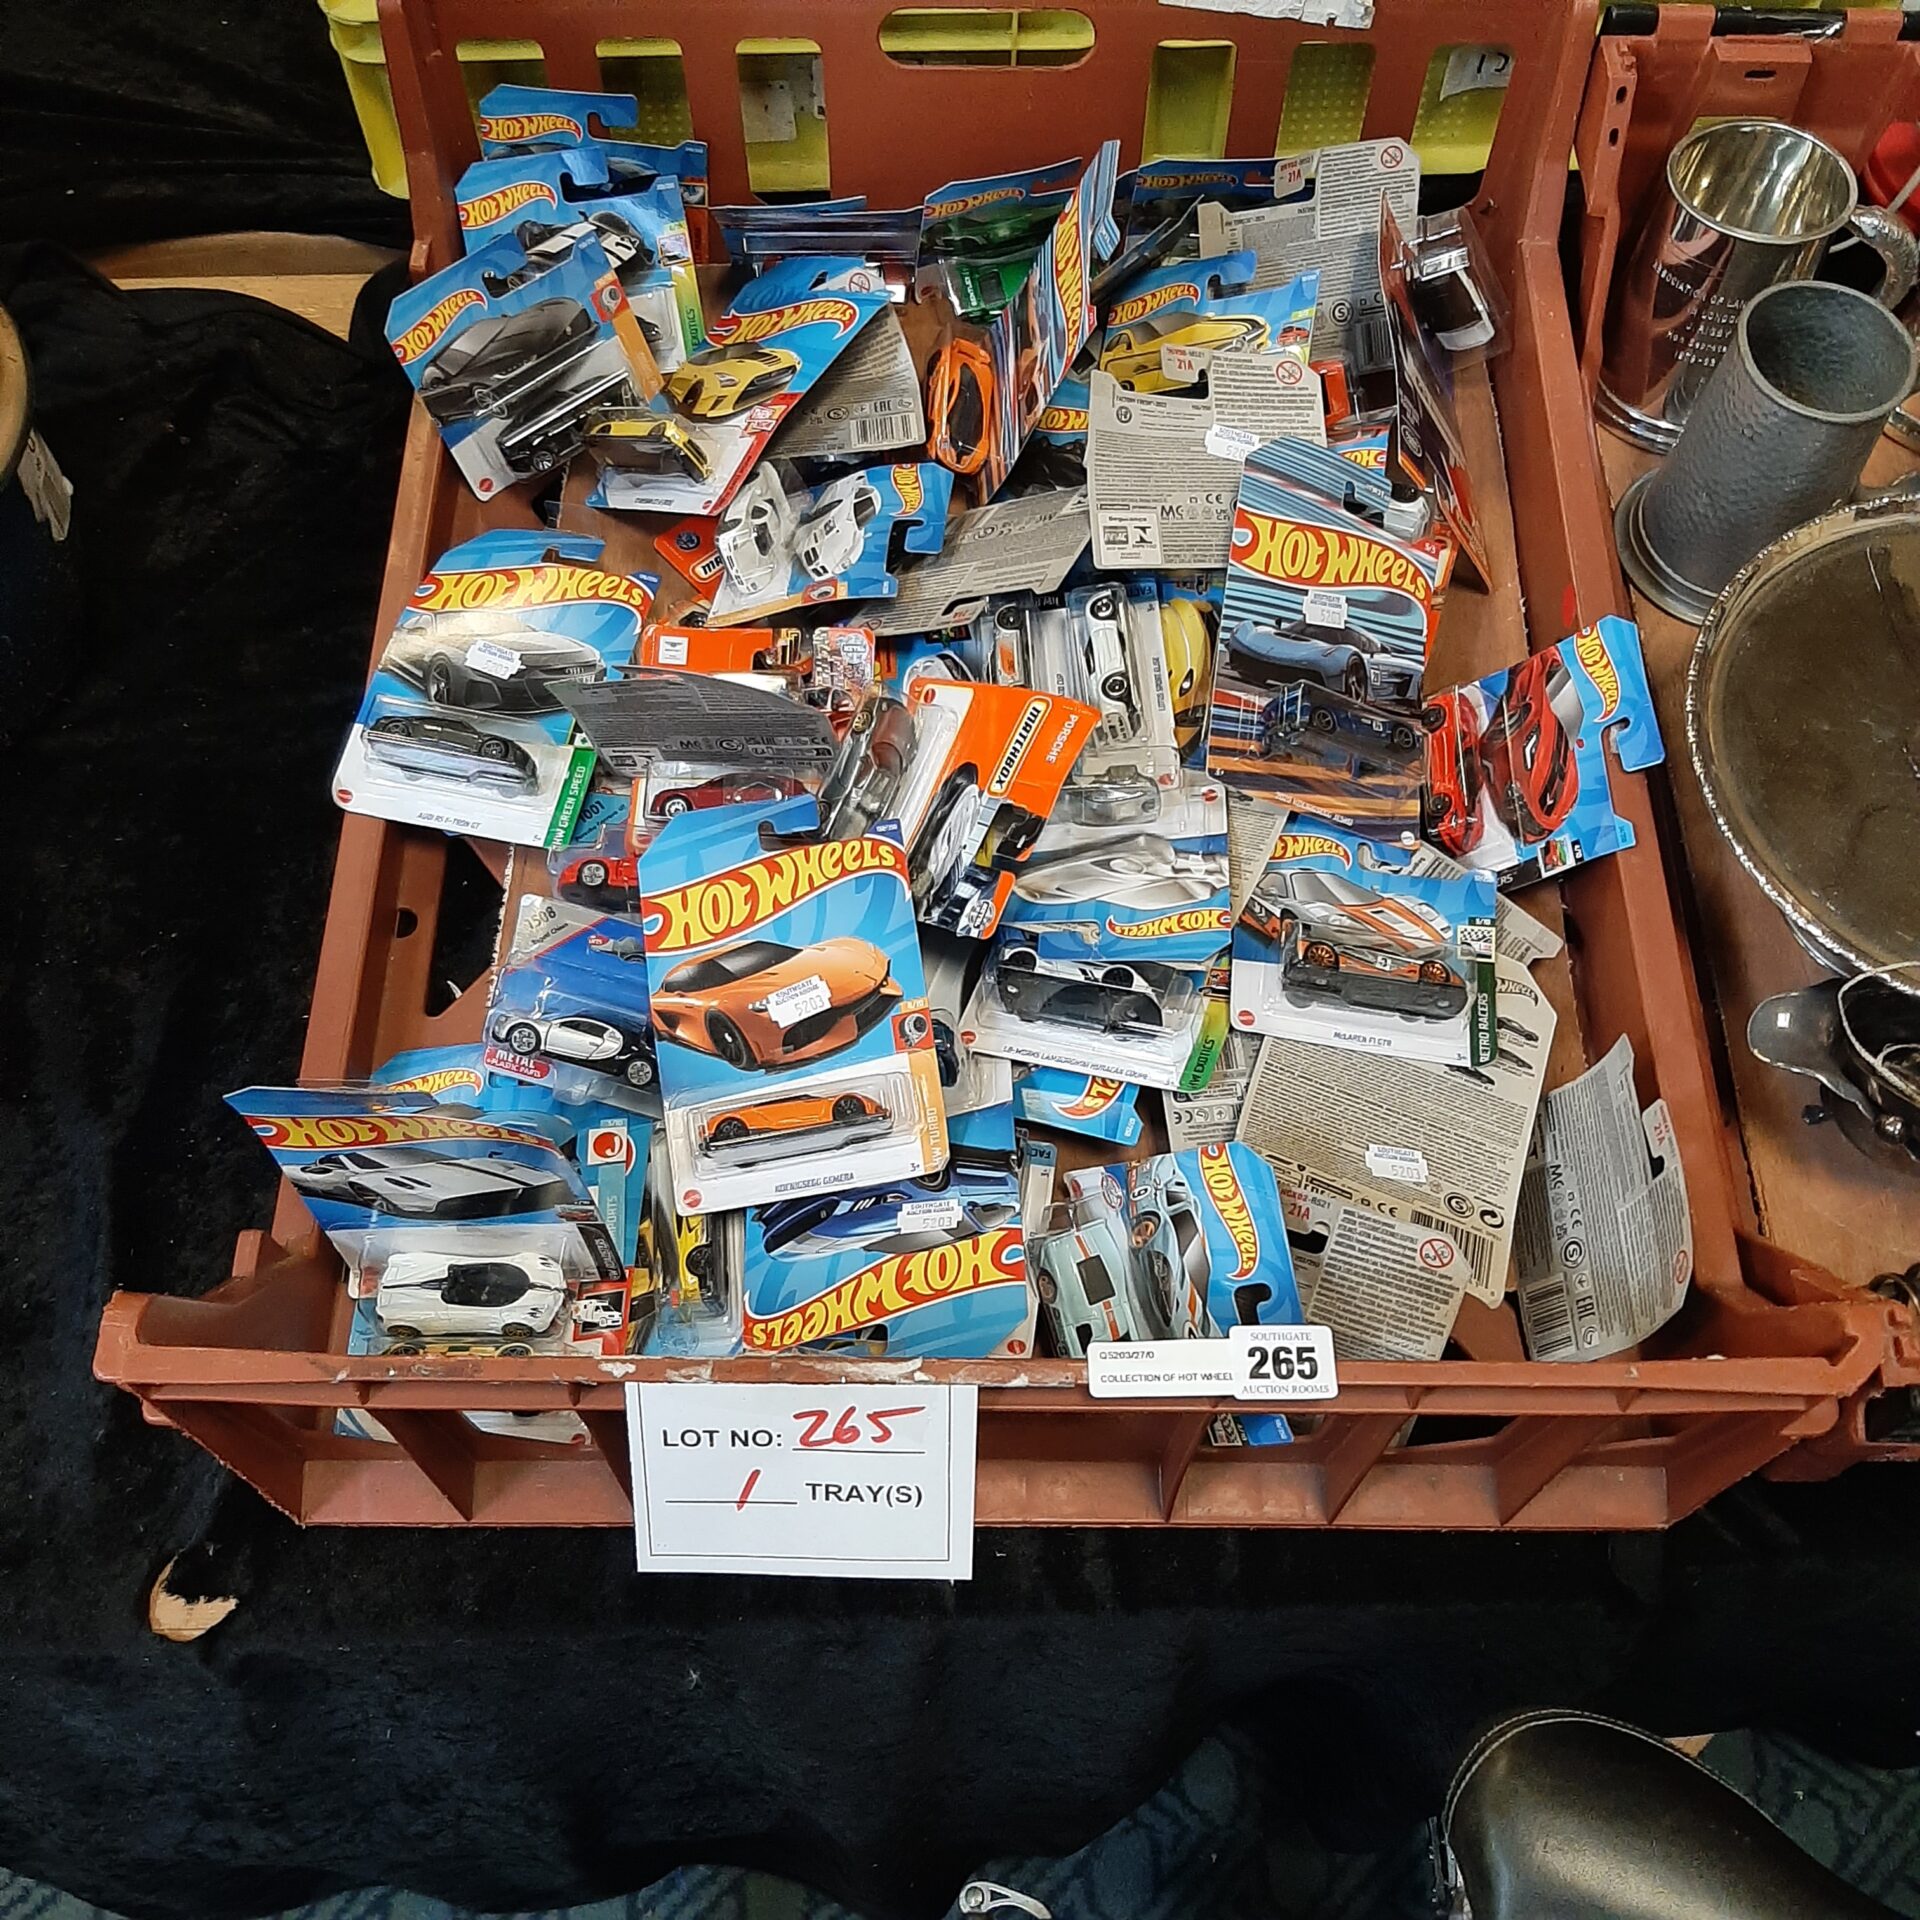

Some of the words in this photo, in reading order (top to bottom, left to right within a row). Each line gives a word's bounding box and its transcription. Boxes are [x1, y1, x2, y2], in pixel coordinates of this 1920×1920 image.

[1226, 444, 1250, 460] 520
[1243, 514, 1326, 580] HOT
[423, 570, 515, 610] HOT
[993, 705, 1043, 790] MATCHBOX
[1046, 714, 1079, 765] PORSCHE
[559, 797, 577, 828] GREEN
[569, 766, 587, 796] SPEED
[649, 878, 753, 950] HOT
[794, 995, 825, 1017] 5203
[1478, 992, 1489, 1028] RACERS
[1479, 1028, 1490, 1063] RETRO
[274, 1116, 375, 1148] HOT
[927, 1107, 942, 1147] TURBO
[1391, 1164, 1421, 1180] 5203
[922, 1216, 953, 1229] 5203
[1287, 1203, 1311, 1221] 21A
[903, 1230, 1018, 1295] HOT
[1250, 1332, 1312, 1342] SOUTHGATE
[1100, 1373, 1161, 1383] COLLECTION
[1163, 1373, 1176, 1382] OF
[1178, 1372, 1198, 1382] HOT
[1247, 1346, 1319, 1380] 265
[1242, 1384, 1289, 1395] AUCTION
[1291, 1384, 1330, 1394] ROOMS
[662, 1429, 720, 1448] LOT
[730, 1429, 783, 1449] NO:
[792, 1405, 926, 1448] 265
[805, 1482, 924, 1508] TRAY(S)
